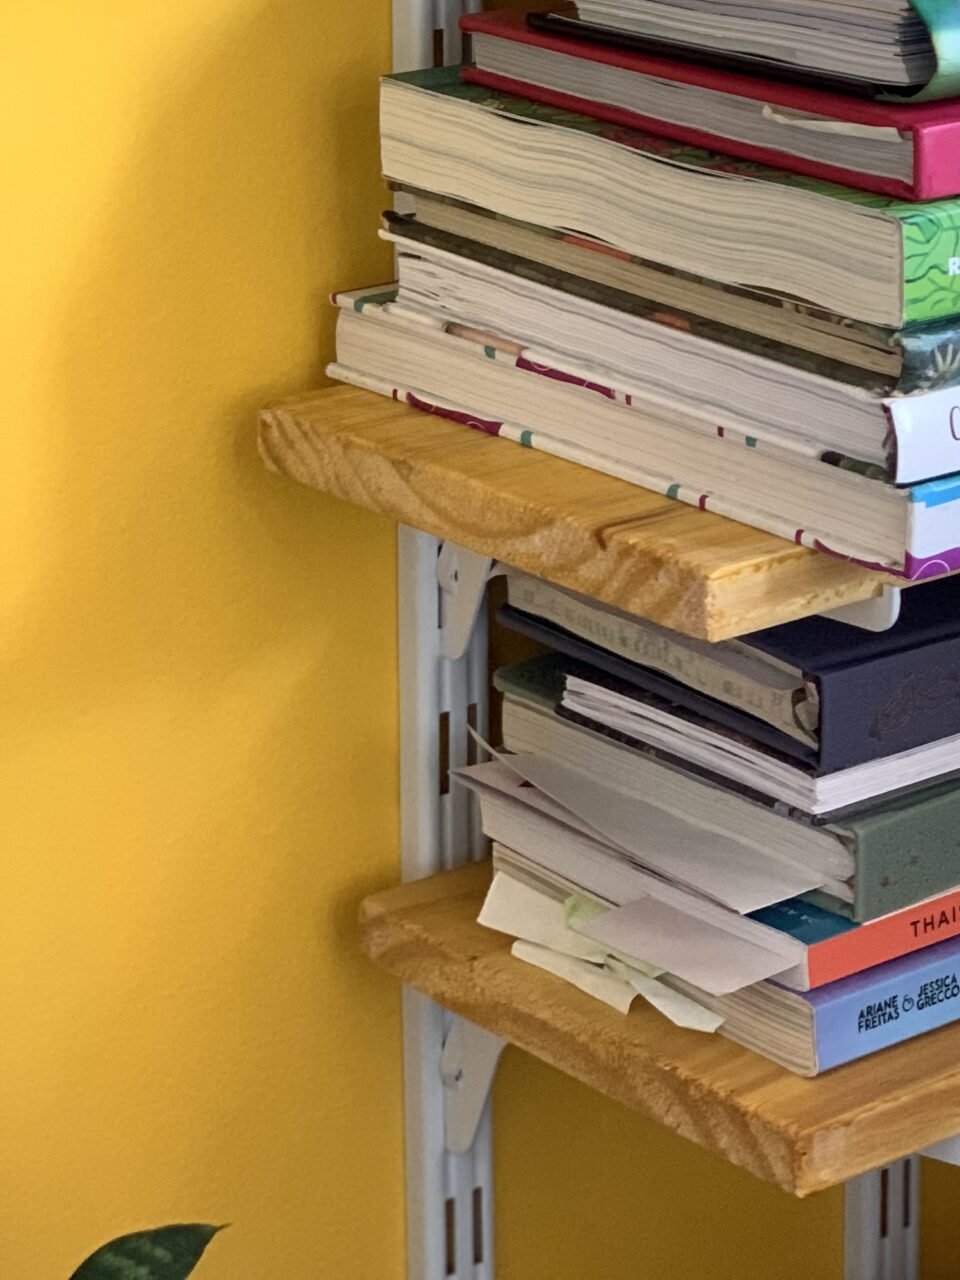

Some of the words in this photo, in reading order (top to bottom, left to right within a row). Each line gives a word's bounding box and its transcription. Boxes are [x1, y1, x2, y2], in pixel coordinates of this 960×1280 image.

[916, 984, 960, 1011] GRECCO
[917, 973, 958, 998] JESSICA
[858, 995, 899, 1019] ARIANE
[858, 1006, 900, 1033] FREITAS
